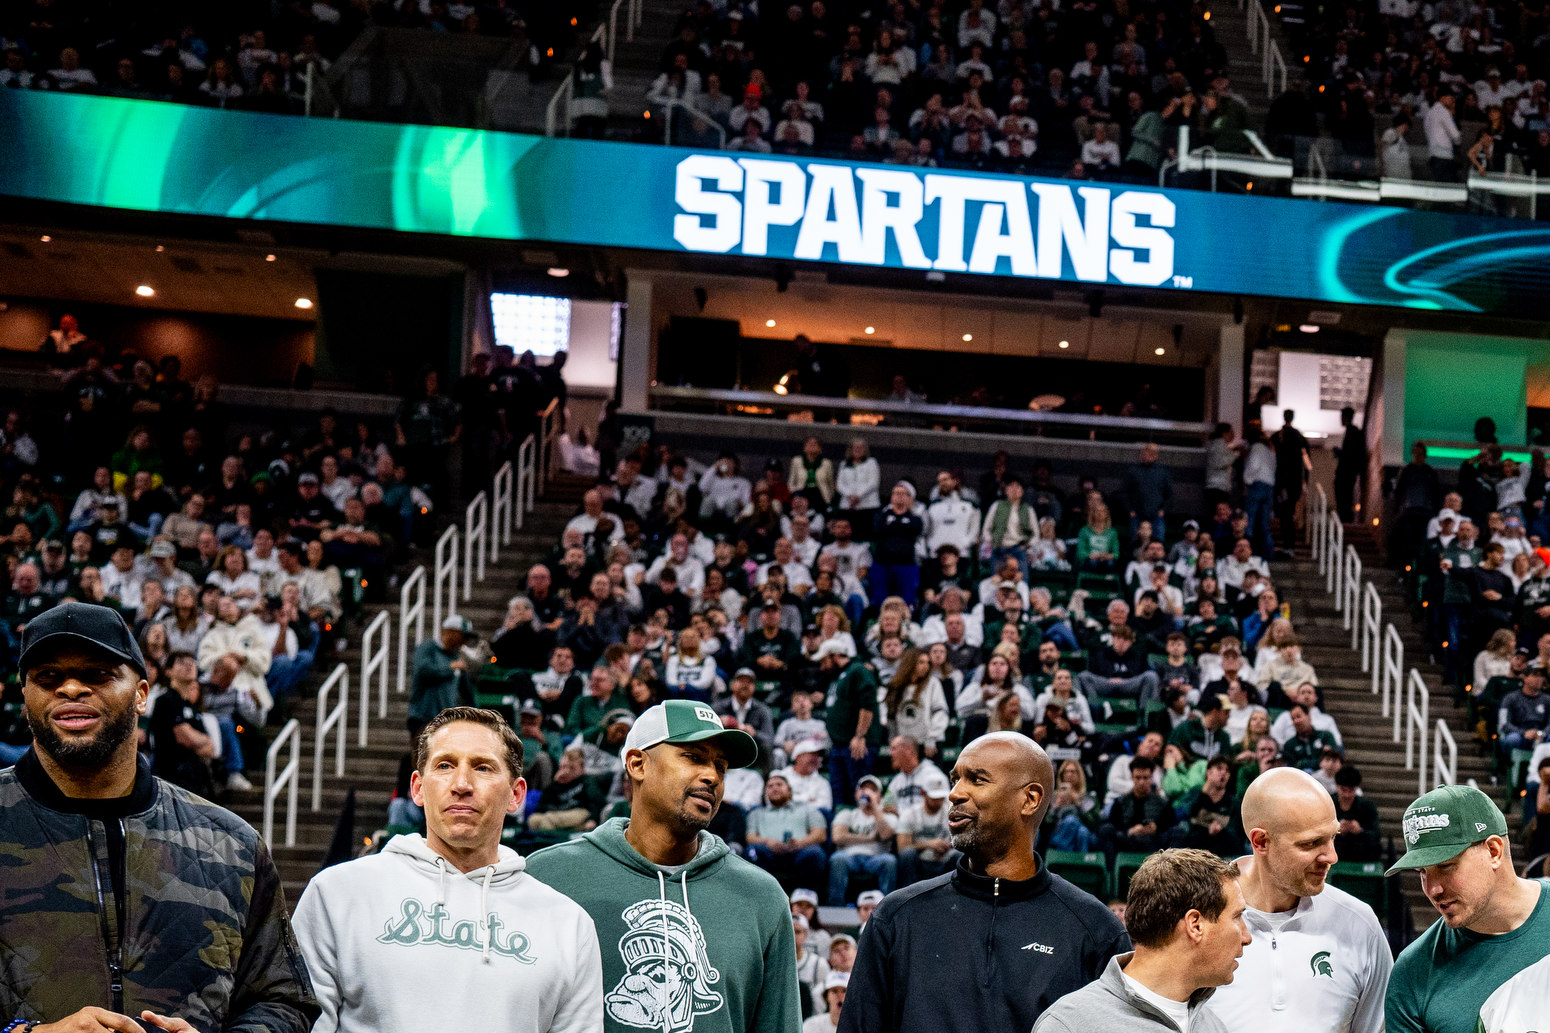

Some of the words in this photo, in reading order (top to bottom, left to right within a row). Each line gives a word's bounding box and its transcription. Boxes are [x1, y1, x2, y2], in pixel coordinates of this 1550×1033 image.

[674, 154, 1175, 287] SPARTANS
[699, 710, 714, 720] 517
[376, 897, 538, 966] State
[1033, 943, 1055, 955] CBIZ
